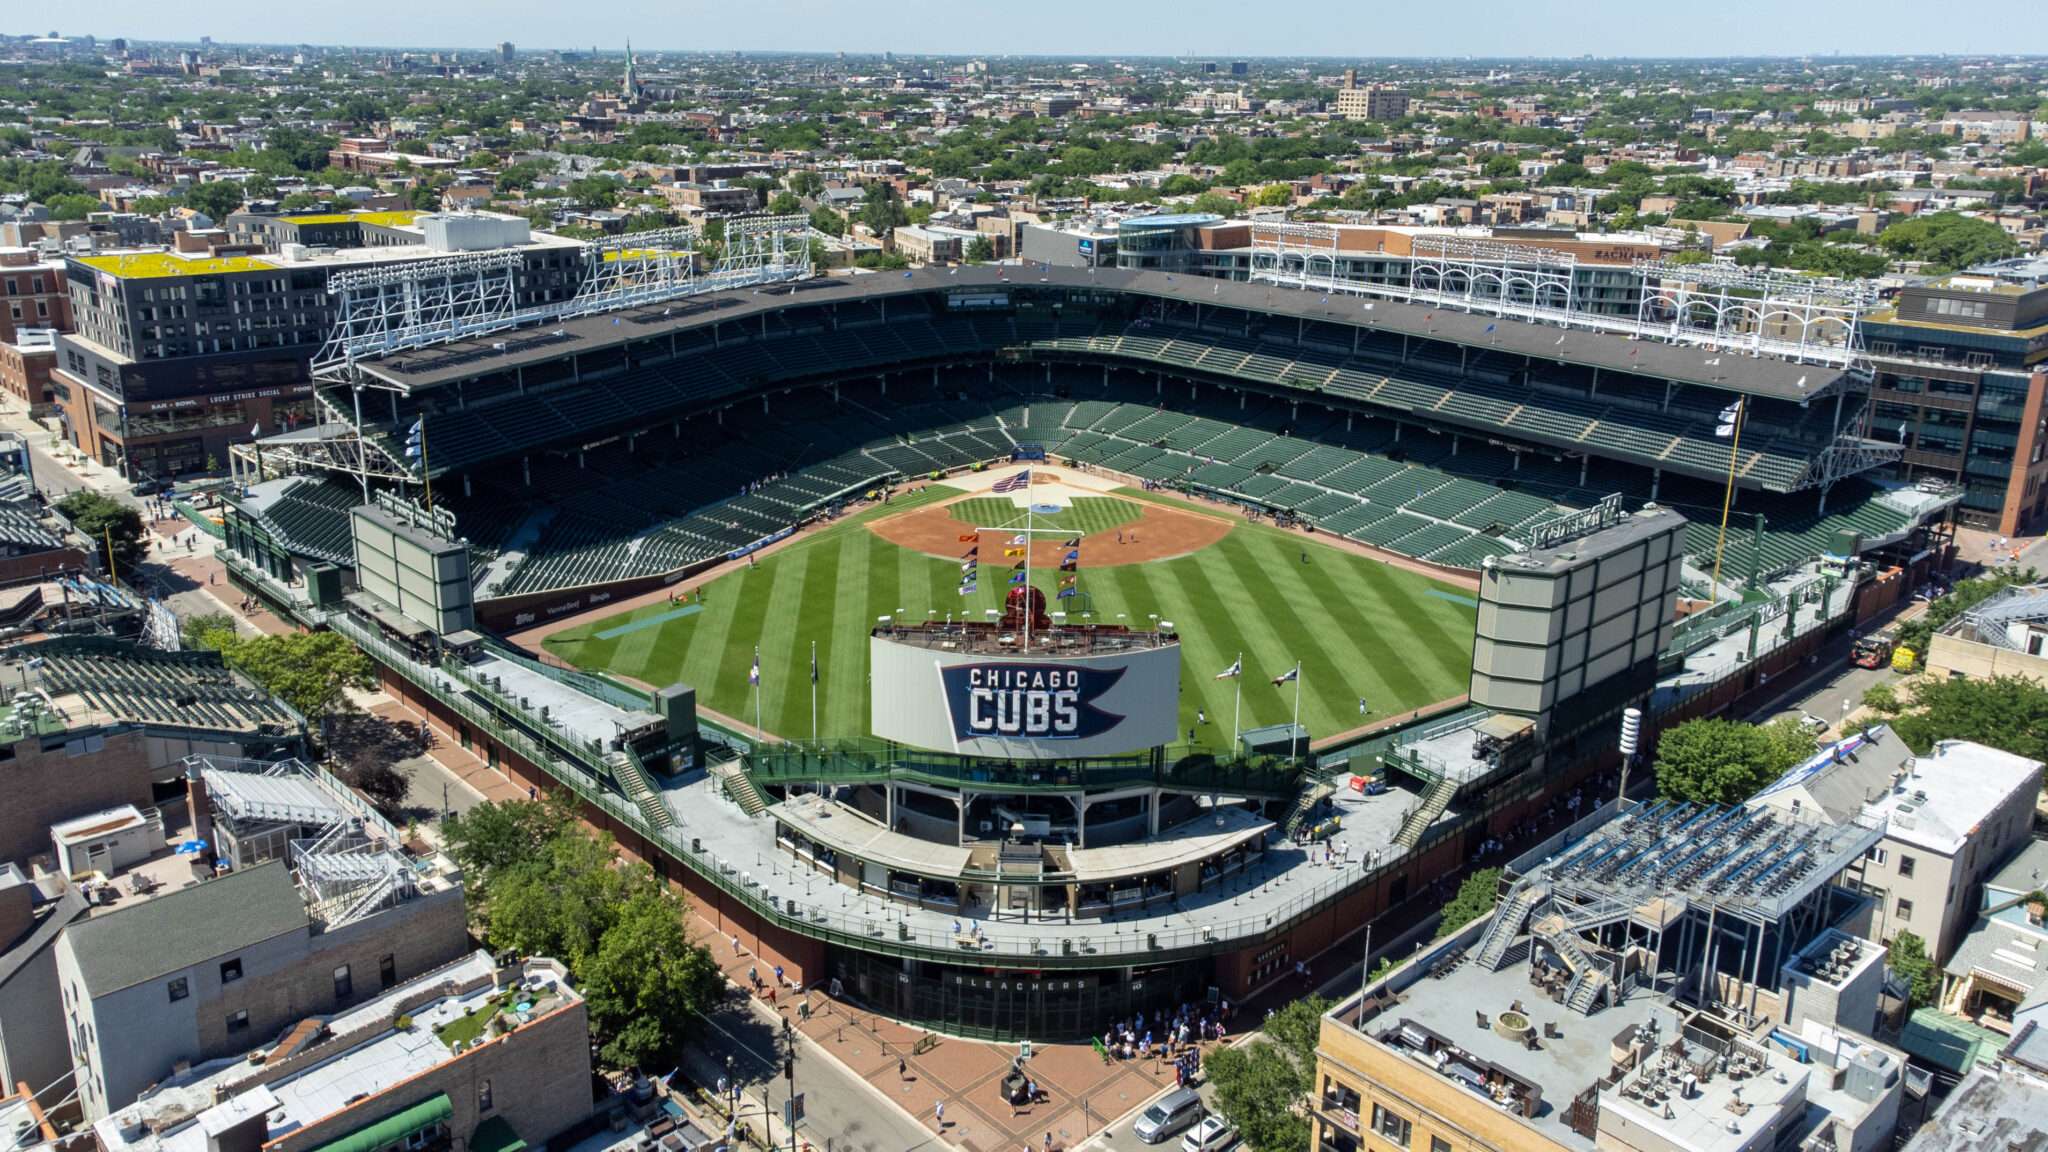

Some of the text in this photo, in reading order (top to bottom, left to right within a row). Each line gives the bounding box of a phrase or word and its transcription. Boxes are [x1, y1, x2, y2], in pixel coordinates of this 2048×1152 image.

[175, 399, 197, 408] BOWL
[209, 389, 281, 404] LUCKY STRIKE SOCIAL
[970, 668, 1079, 688] CHICAGO
[970, 688, 1078, 732] CUBS
[956, 976, 1085, 991] BLEACHERS
